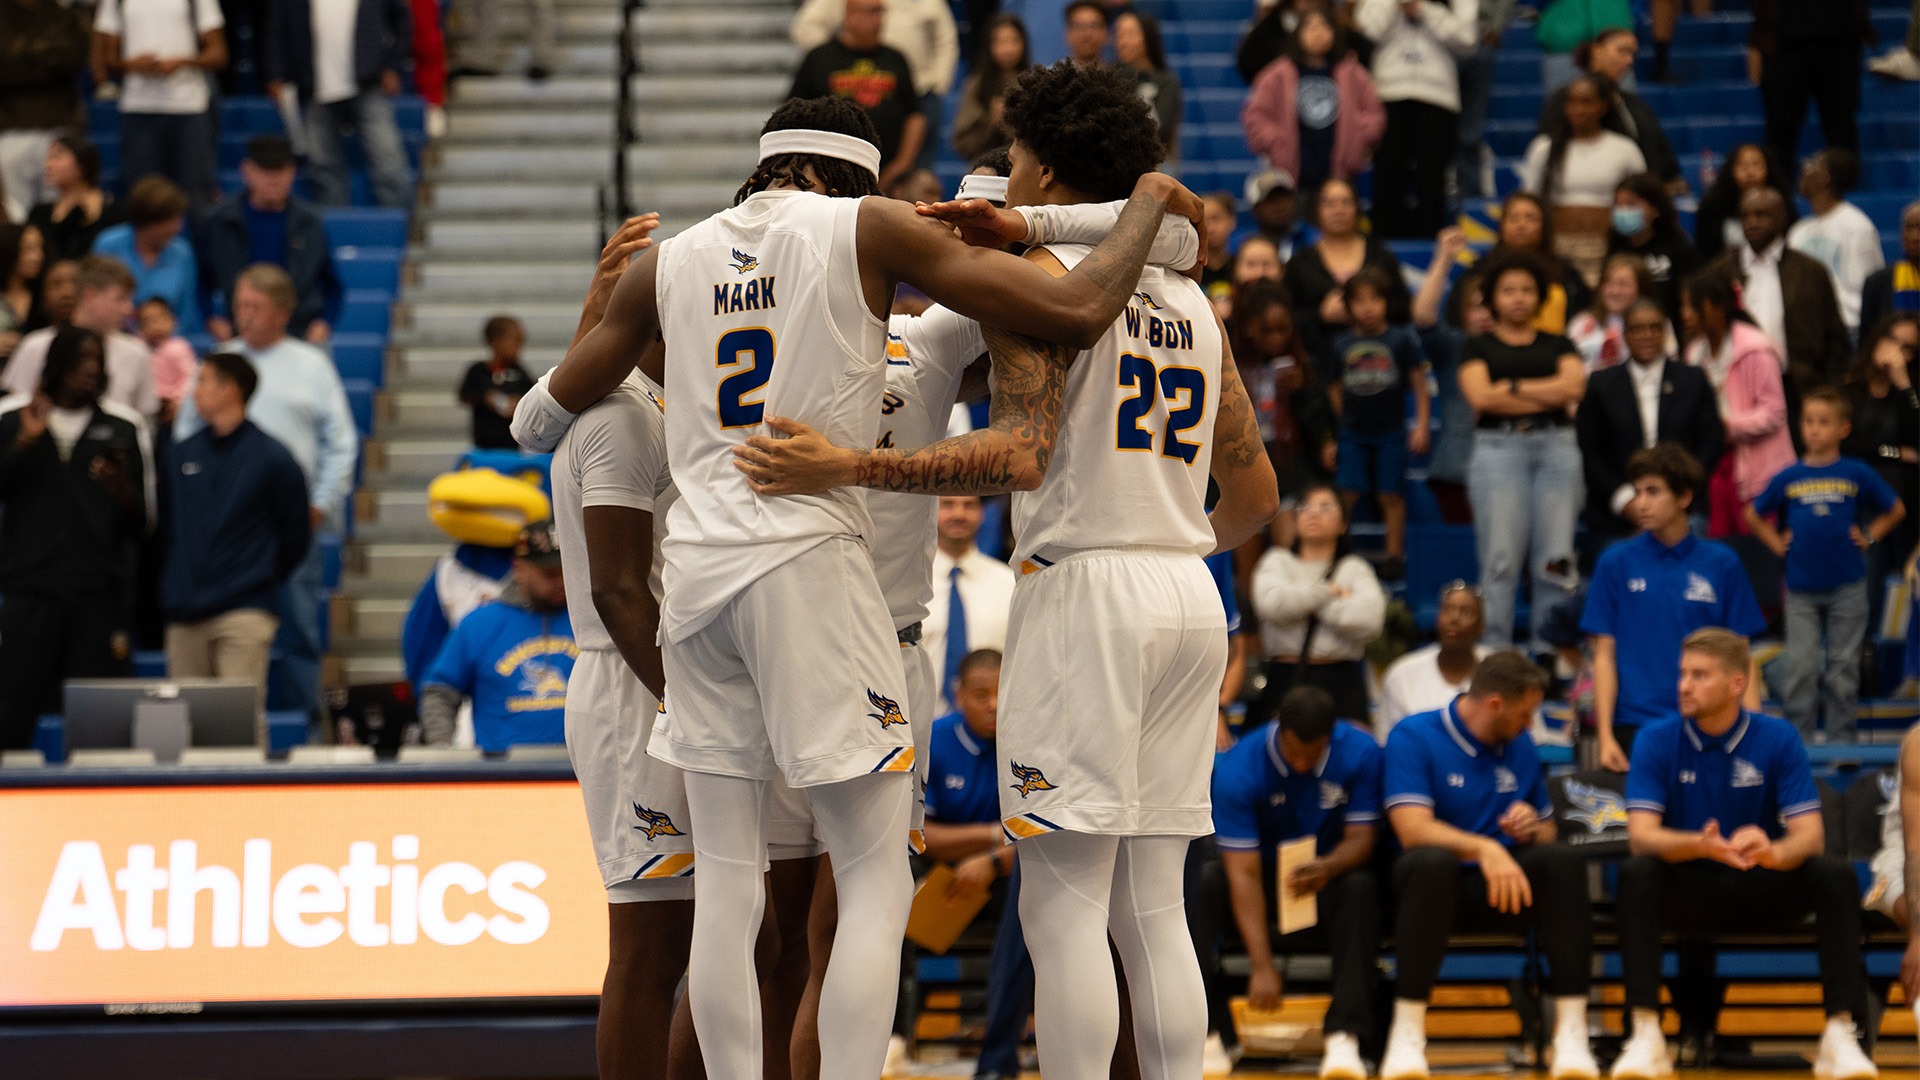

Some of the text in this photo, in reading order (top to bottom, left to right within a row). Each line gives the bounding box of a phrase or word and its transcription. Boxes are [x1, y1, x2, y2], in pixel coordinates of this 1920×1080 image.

[713, 275, 777, 316] MARK
[1125, 305, 1194, 351] WBON
[715, 326, 777, 431] 2
[1115, 351, 1208, 467] 22
[853, 442, 1016, 492] PERSEVERANCE
[29, 834, 551, 951] Athletics
